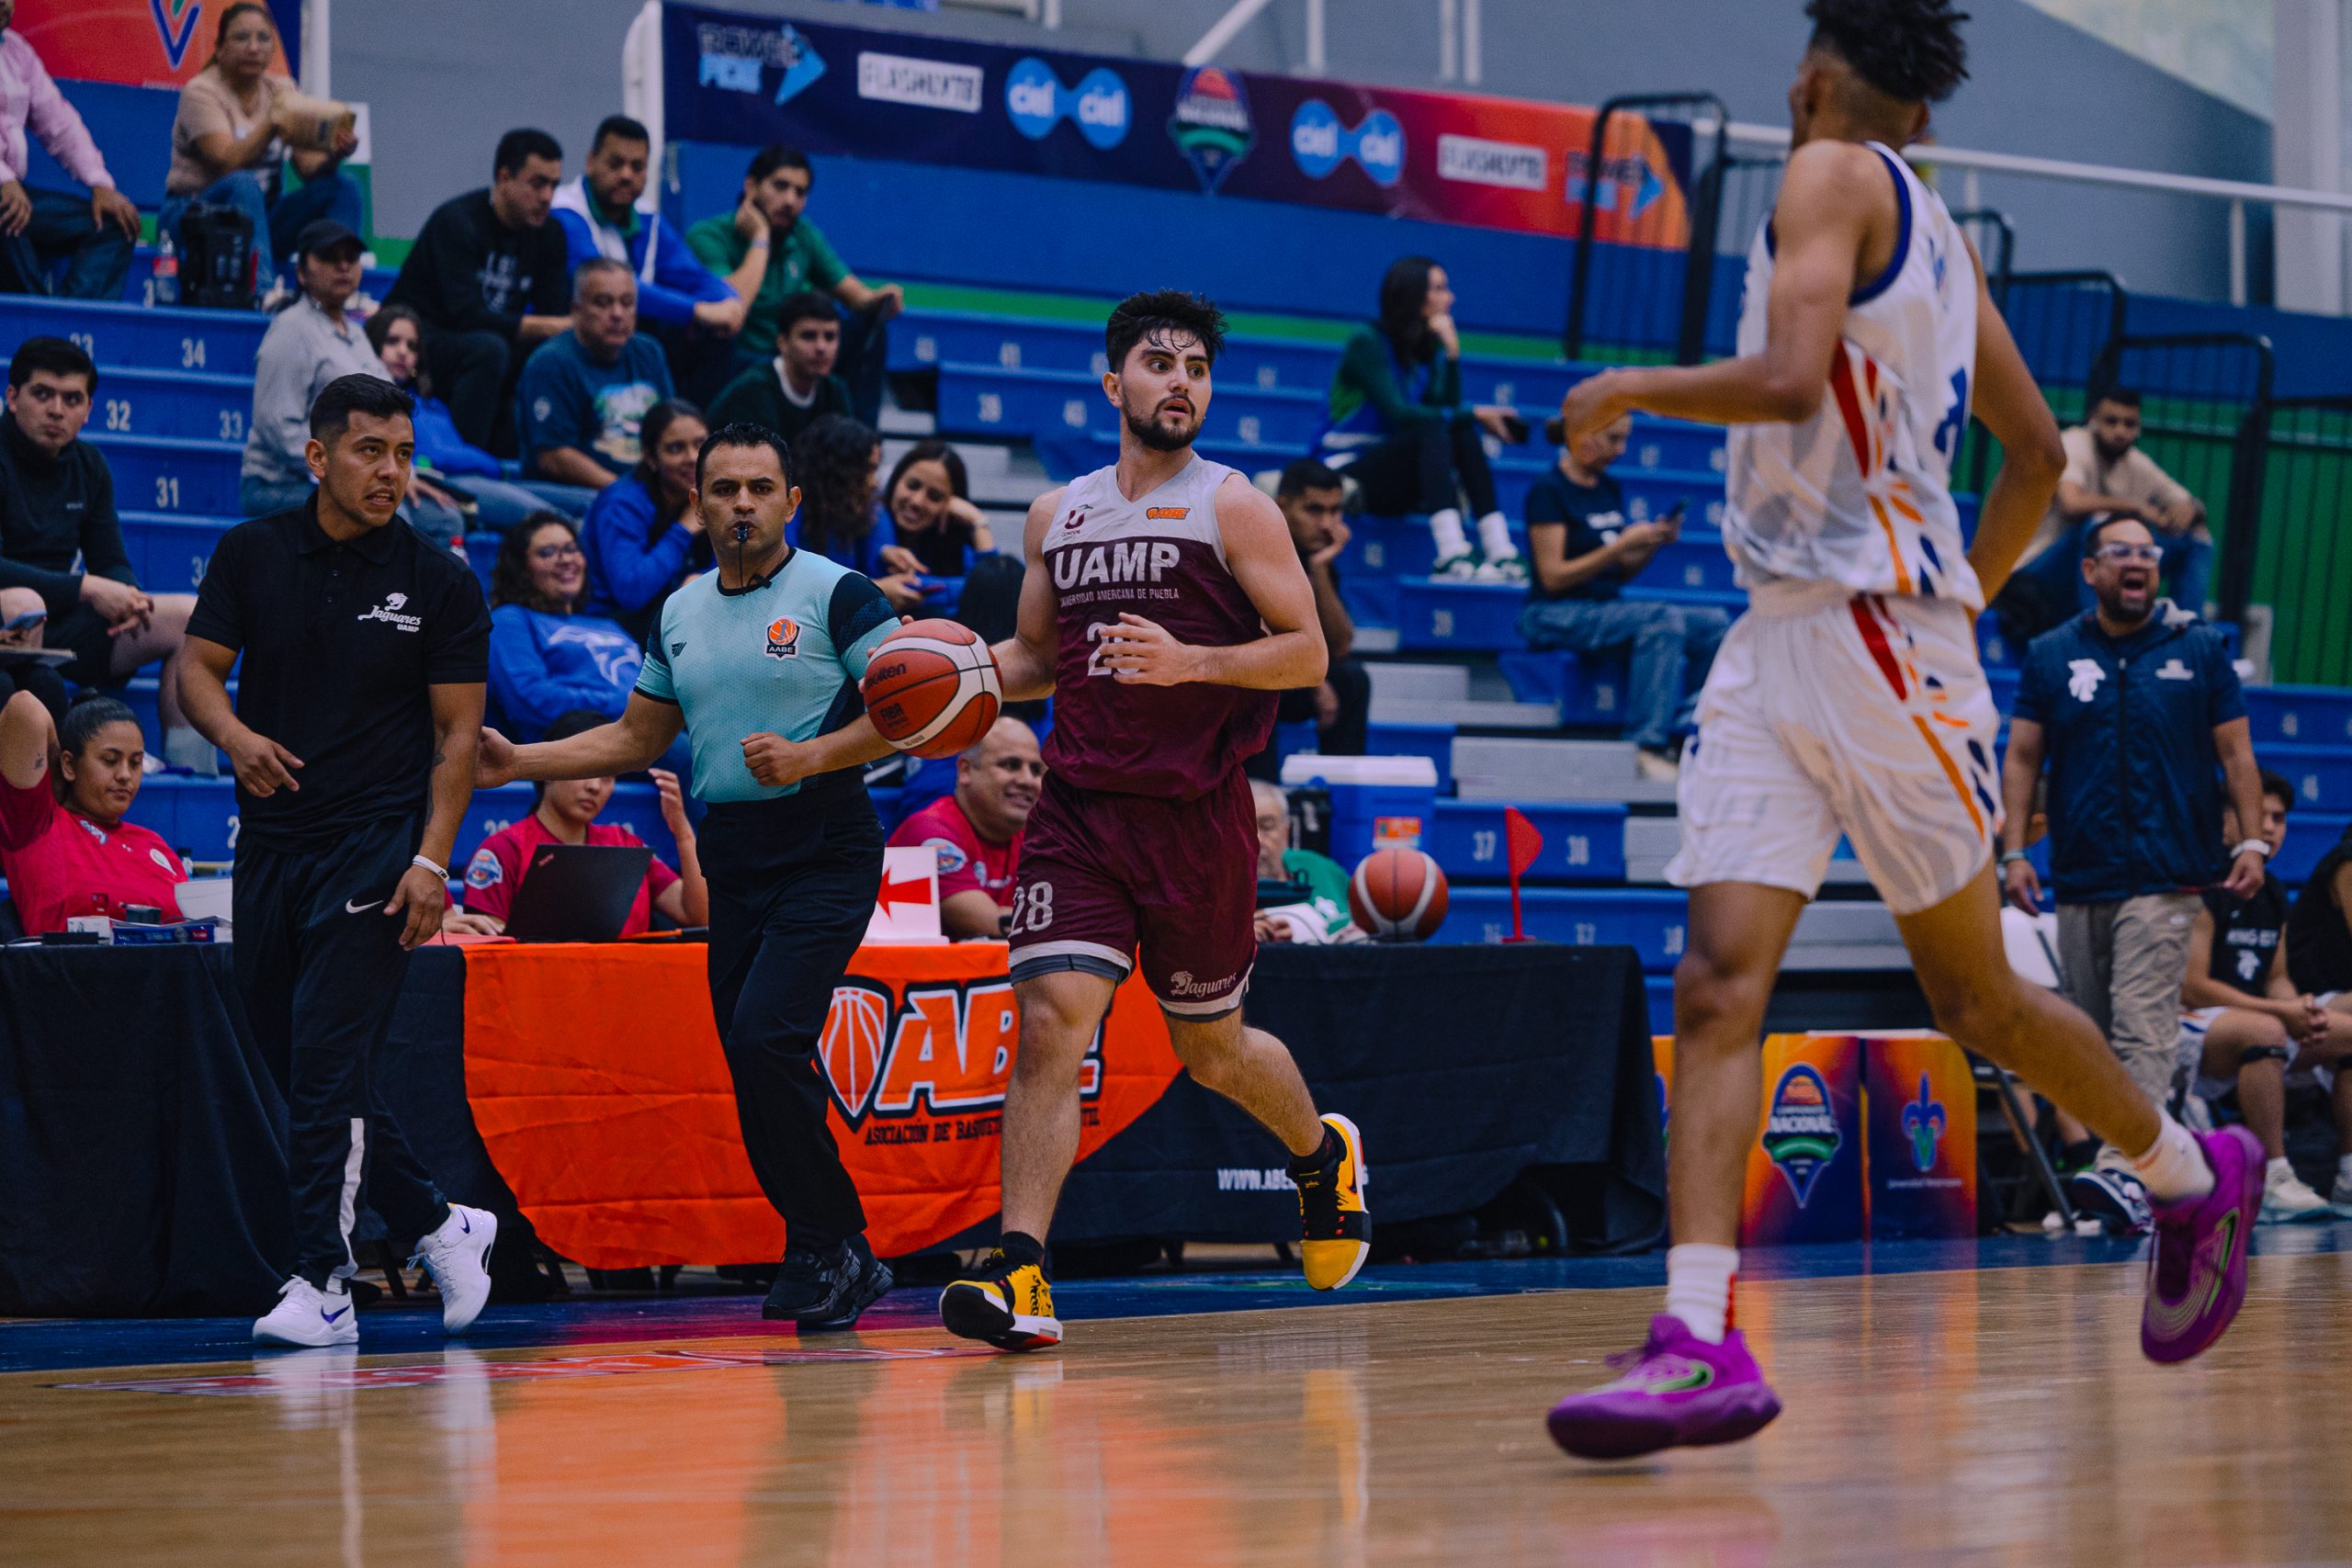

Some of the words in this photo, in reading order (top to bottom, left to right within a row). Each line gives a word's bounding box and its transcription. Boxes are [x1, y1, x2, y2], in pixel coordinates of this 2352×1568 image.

[182, 337, 206, 367] 34
[107, 400, 130, 432] 32
[220, 411, 243, 440] 33
[155, 476, 179, 508] 31
[191, 557, 210, 587] 3
[1054, 542, 1181, 590] UAMP
[1097, 589, 1135, 601] AMERICANA
[1137, 589, 1148, 599] DE
[1149, 588, 1180, 599] PUEBLA
[357, 605, 422, 626] Jaguares
[397, 624, 420, 633] UAMP
[1473, 830, 1497, 862] 37
[1008, 882, 1053, 939] 28
[865, 1118, 929, 1145] ASOCIACIÓN
[933, 1122, 950, 1142] DE
